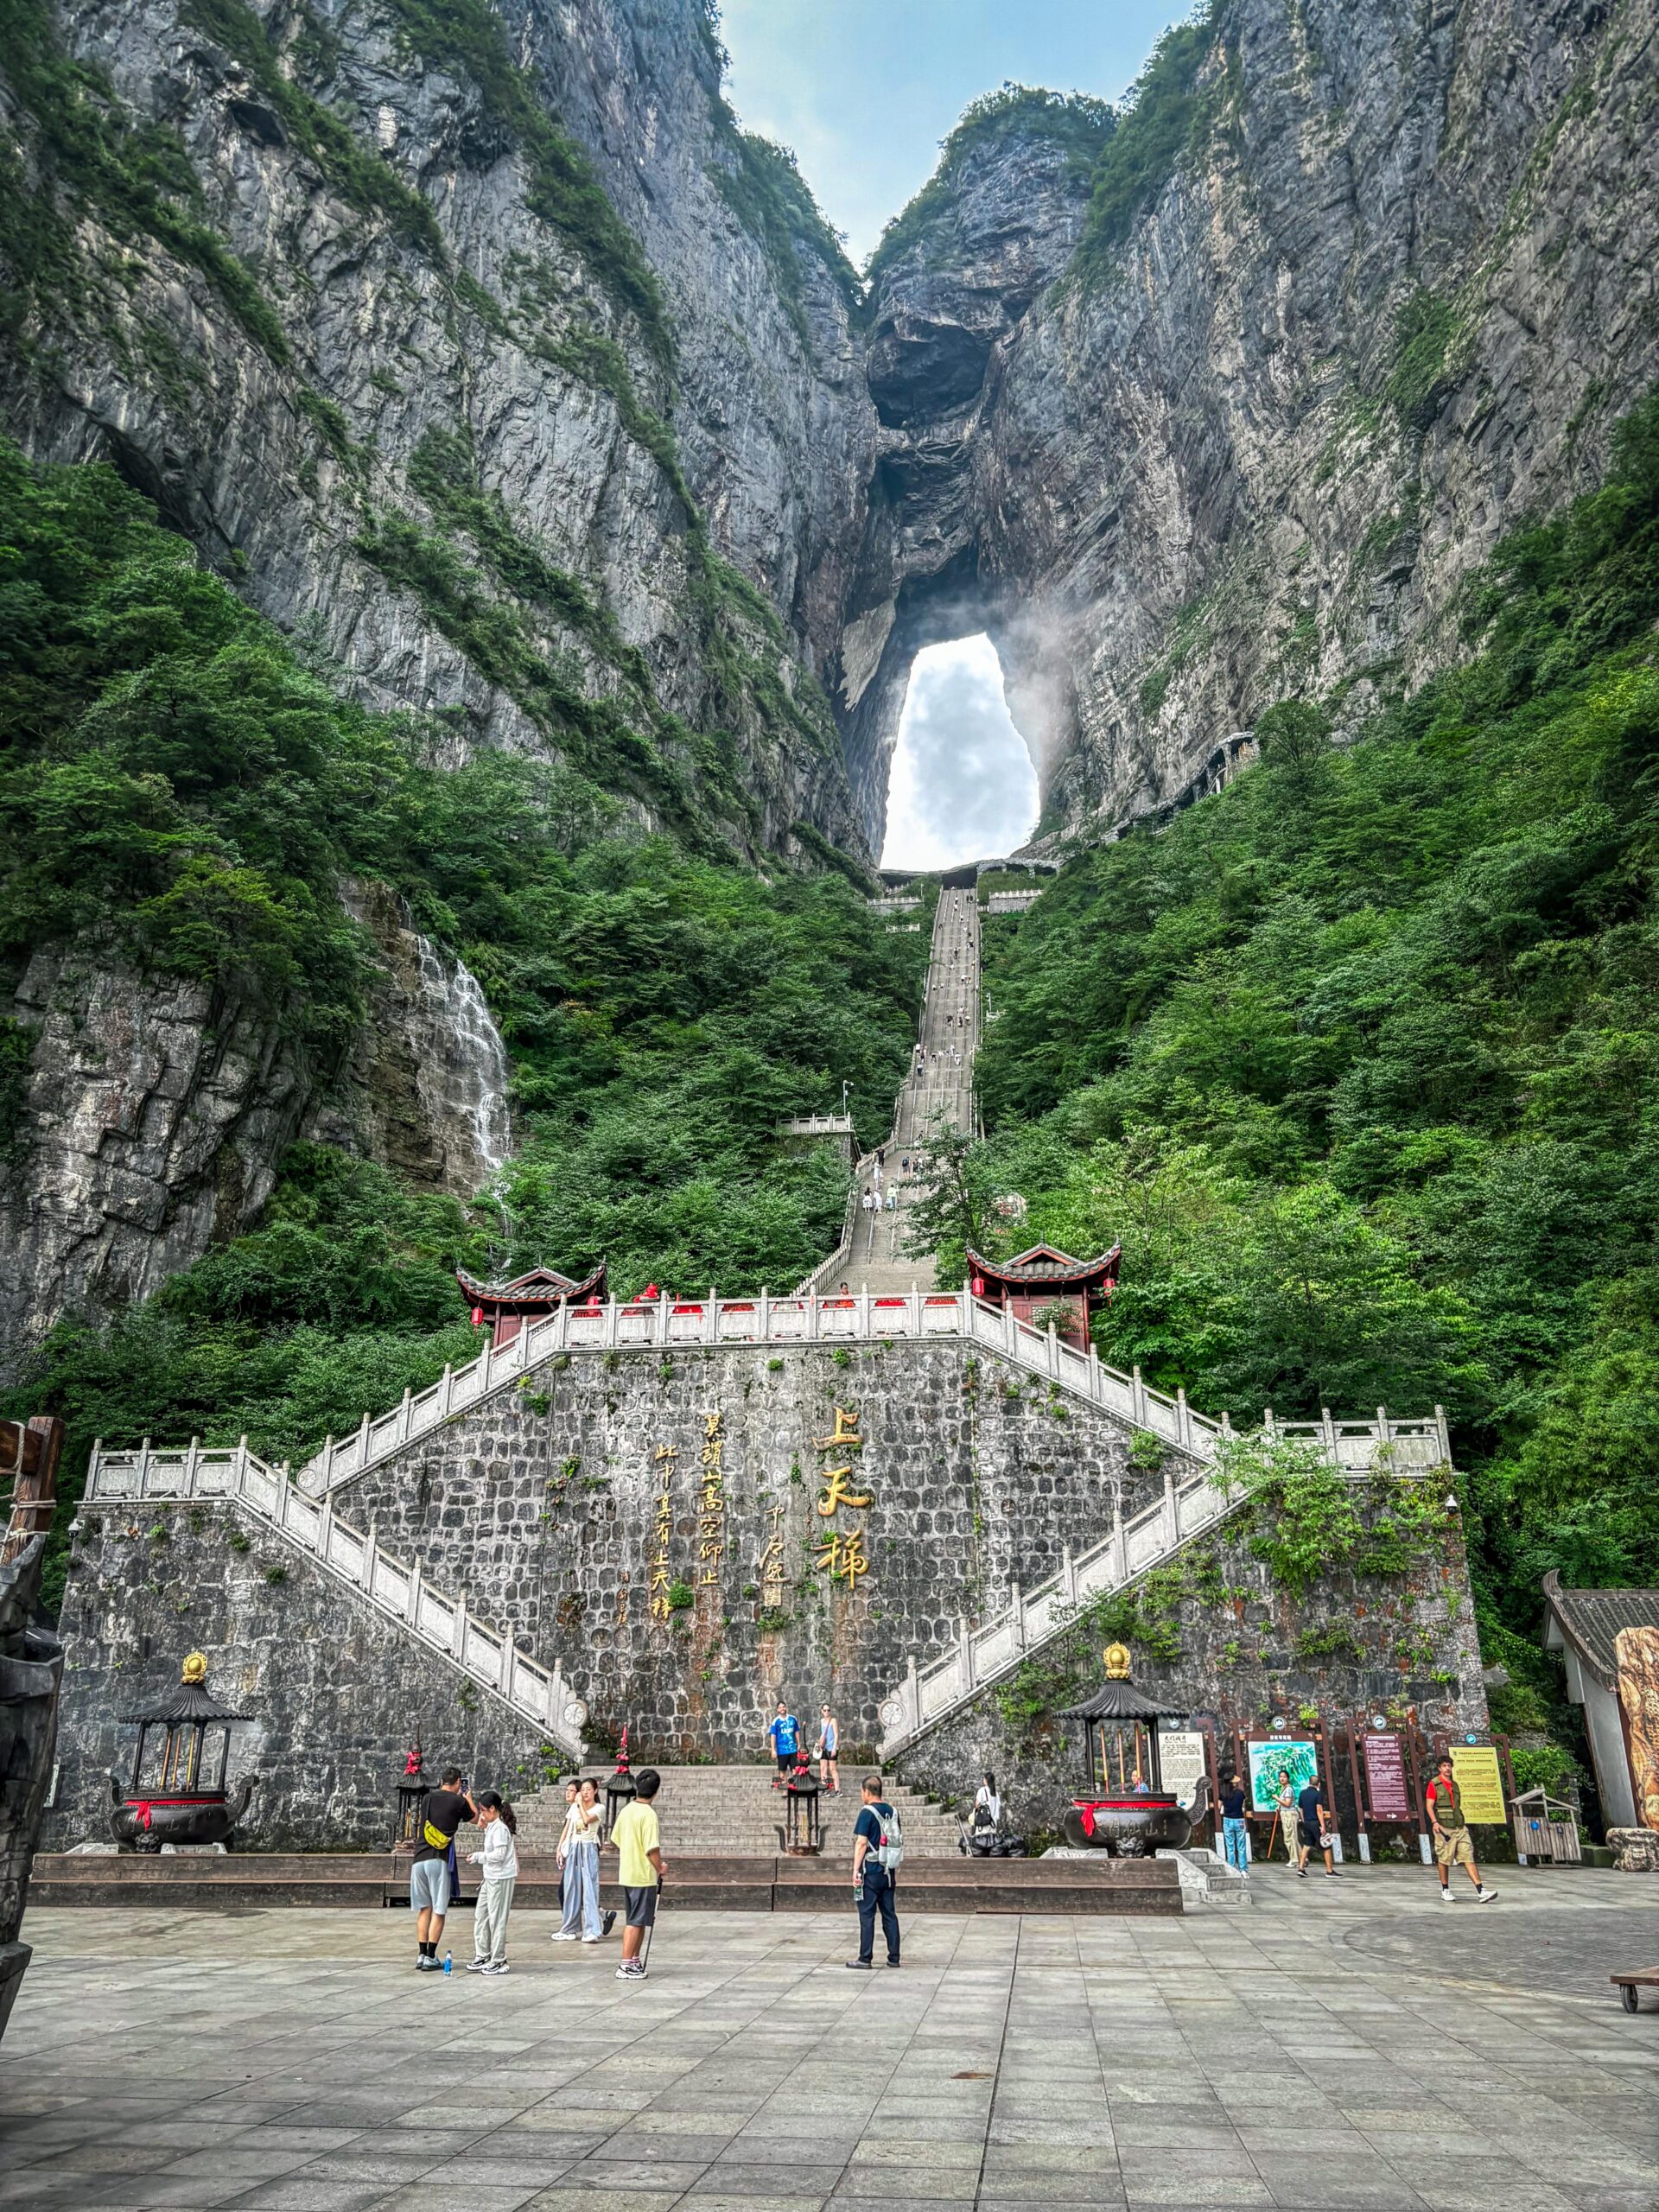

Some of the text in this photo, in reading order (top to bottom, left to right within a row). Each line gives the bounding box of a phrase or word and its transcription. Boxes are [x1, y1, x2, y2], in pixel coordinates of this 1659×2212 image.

[699, 1414, 724, 1586] 莫謂山高空仰止
[810, 1406, 870, 1590] 上天梯
